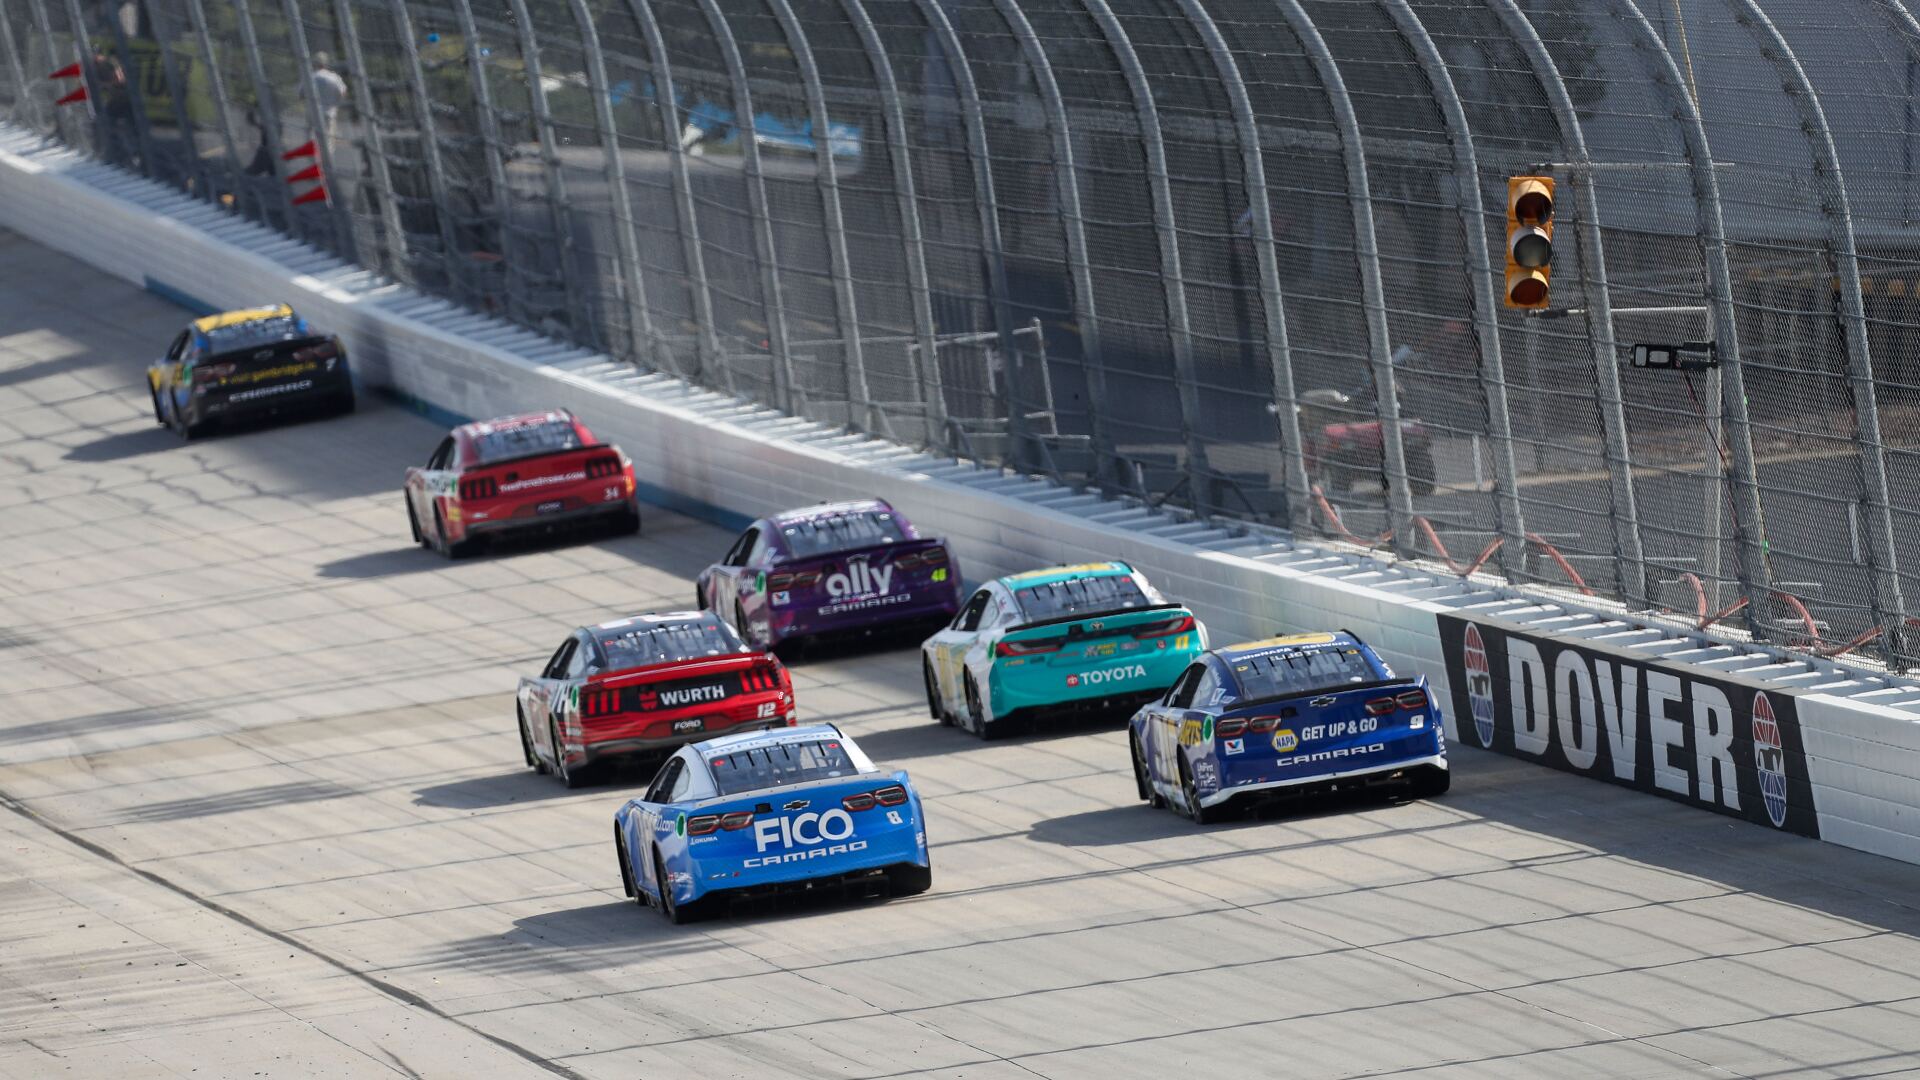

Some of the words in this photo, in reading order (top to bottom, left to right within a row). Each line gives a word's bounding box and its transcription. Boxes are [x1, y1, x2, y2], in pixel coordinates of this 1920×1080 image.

[825, 561, 894, 597] ally
[818, 593, 912, 616] CAMARO
[1080, 664, 1147, 686] TOYOTA
[757, 702, 776, 718] 12
[1409, 714, 1424, 729] 9
[674, 719, 702, 731] FORD
[1301, 725, 1326, 741] GET
[1328, 721, 1346, 737] UP
[1347, 720, 1358, 734] &
[1359, 717, 1378, 732] GO
[1506, 635, 1742, 811] DOVER
[1275, 735, 1296, 748] NAPA
[1276, 742, 1385, 767] CAMARO
[886, 810, 903, 825] 8
[753, 808, 854, 853] FICO
[743, 840, 868, 868] CAMARO
